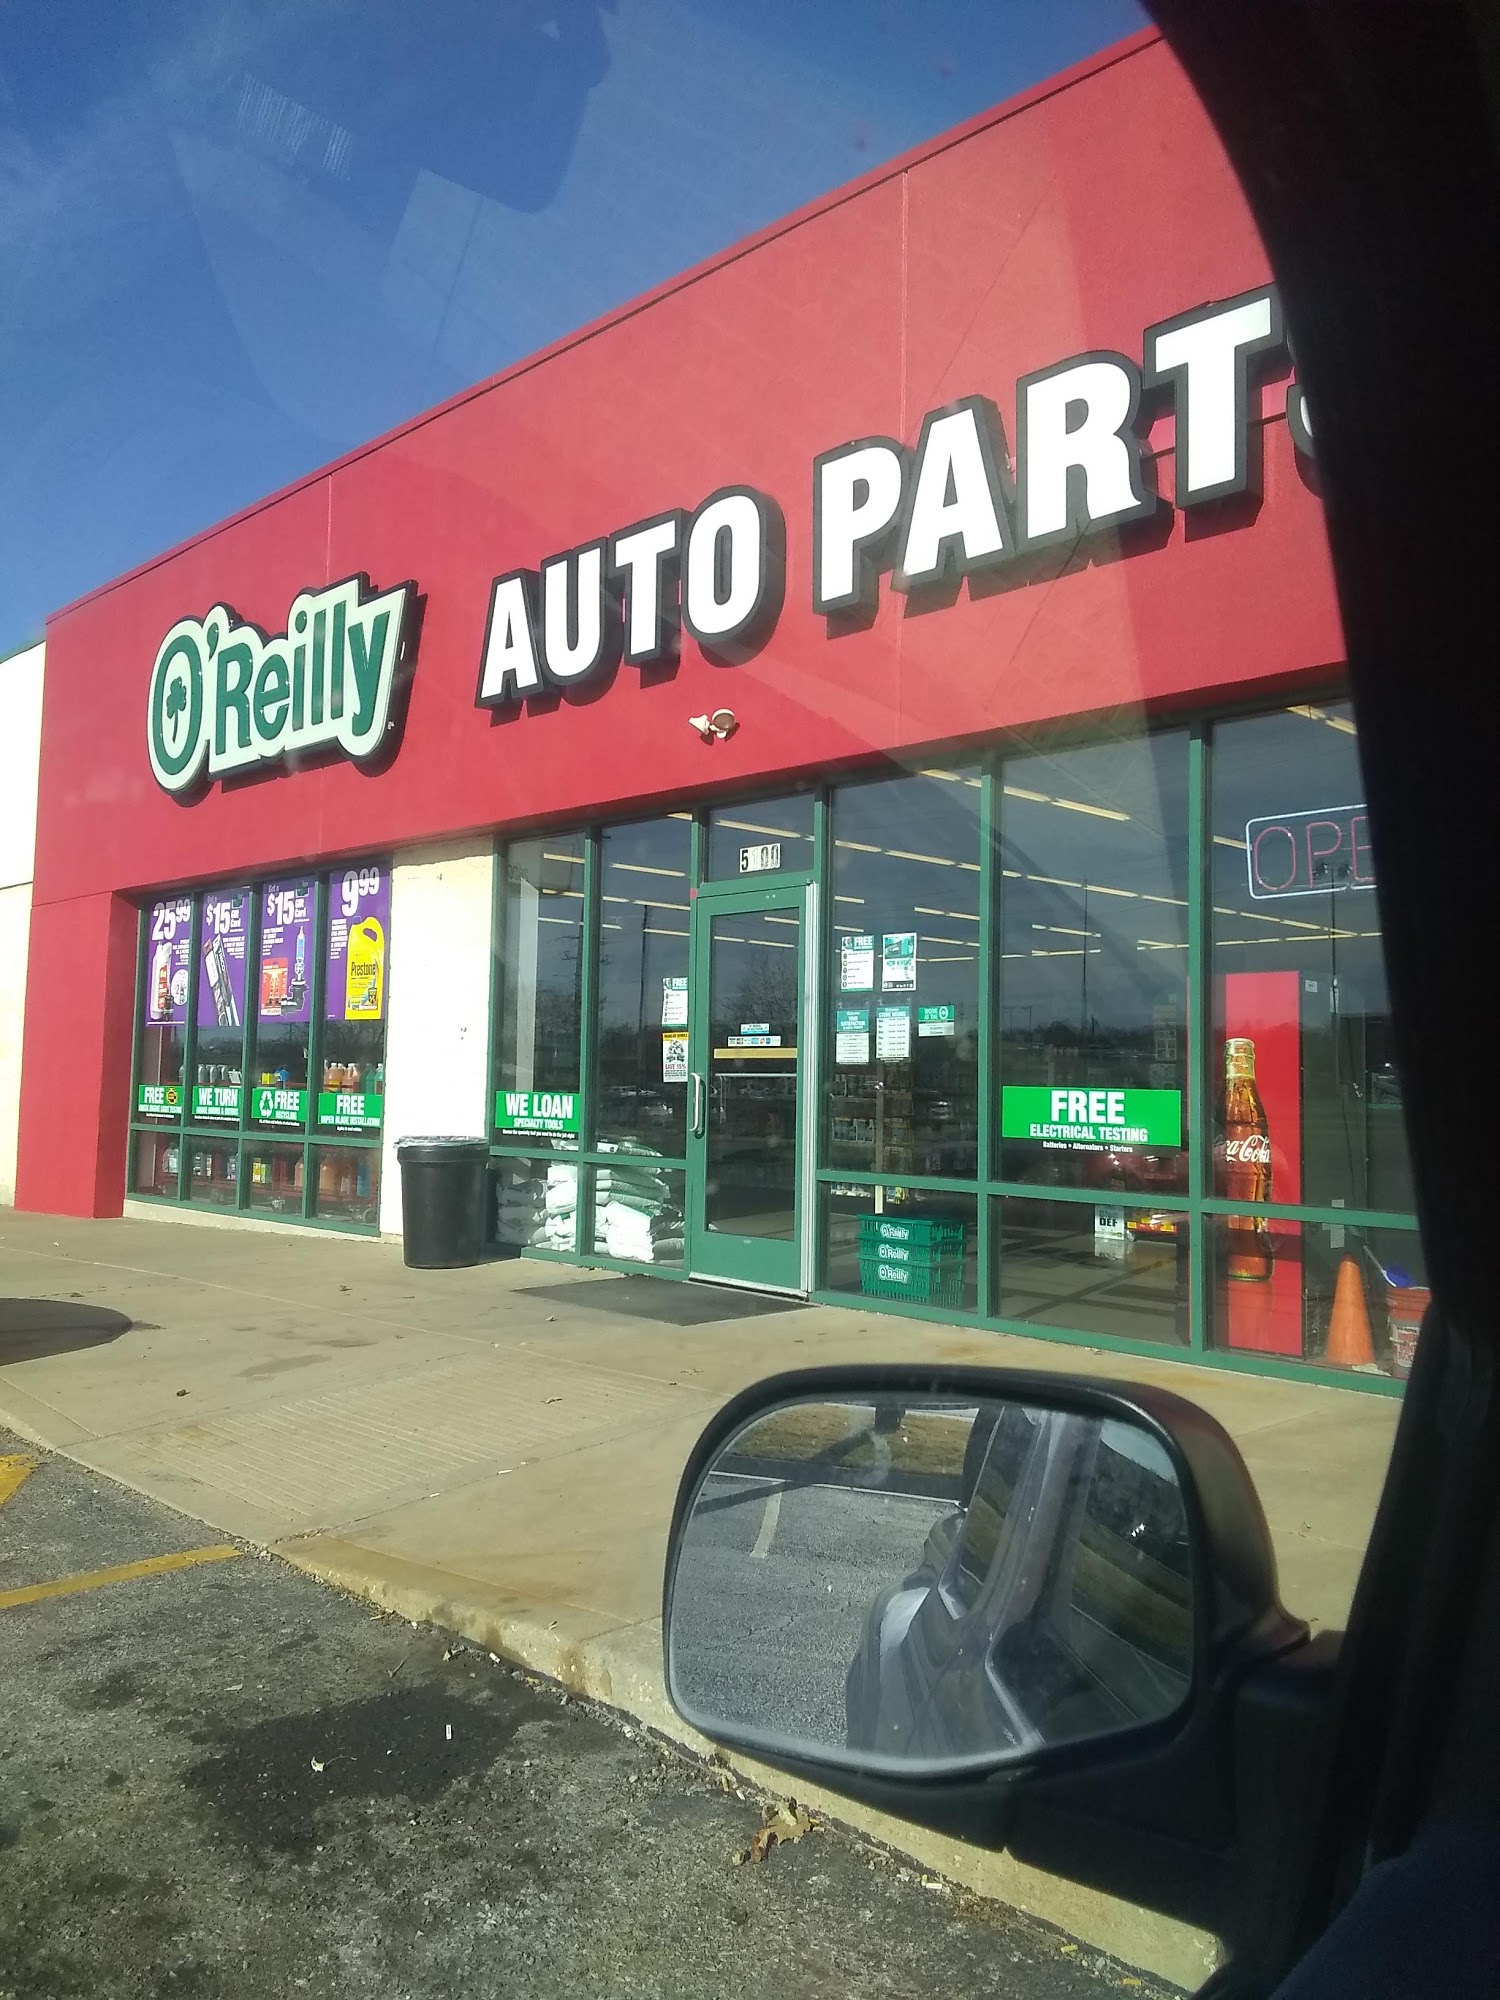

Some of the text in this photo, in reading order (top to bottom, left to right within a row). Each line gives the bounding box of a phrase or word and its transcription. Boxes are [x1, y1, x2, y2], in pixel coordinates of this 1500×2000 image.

[479, 297, 1314, 699] AUTO PART
[150, 592, 398, 782] O'Reilly
[1253, 815, 1377, 891] OPE
[206, 902, 231, 935] $15
[266, 890, 295, 926] $15
[854, 936, 873, 946] FREE
[350, 961, 377, 977] Prestone
[144, 1086, 165, 1105] FREE
[198, 1087, 239, 1107] WE TURN
[274, 1090, 300, 1111] FREE
[336, 1094, 365, 1116] FREE
[505, 1093, 574, 1119] WE LOAN
[1050, 1089, 1126, 1125] FREE
[513, 1117, 564, 1131] SPECIALTY TOOLS
[1029, 1123, 1149, 1143] ELECTRICAL TESTING
[1042, 1140, 1133, 1153] Batteries Alternators Starters
[1214, 1134, 1270, 1164] ca-Cola
[1099, 1217, 1118, 1227] DEF
